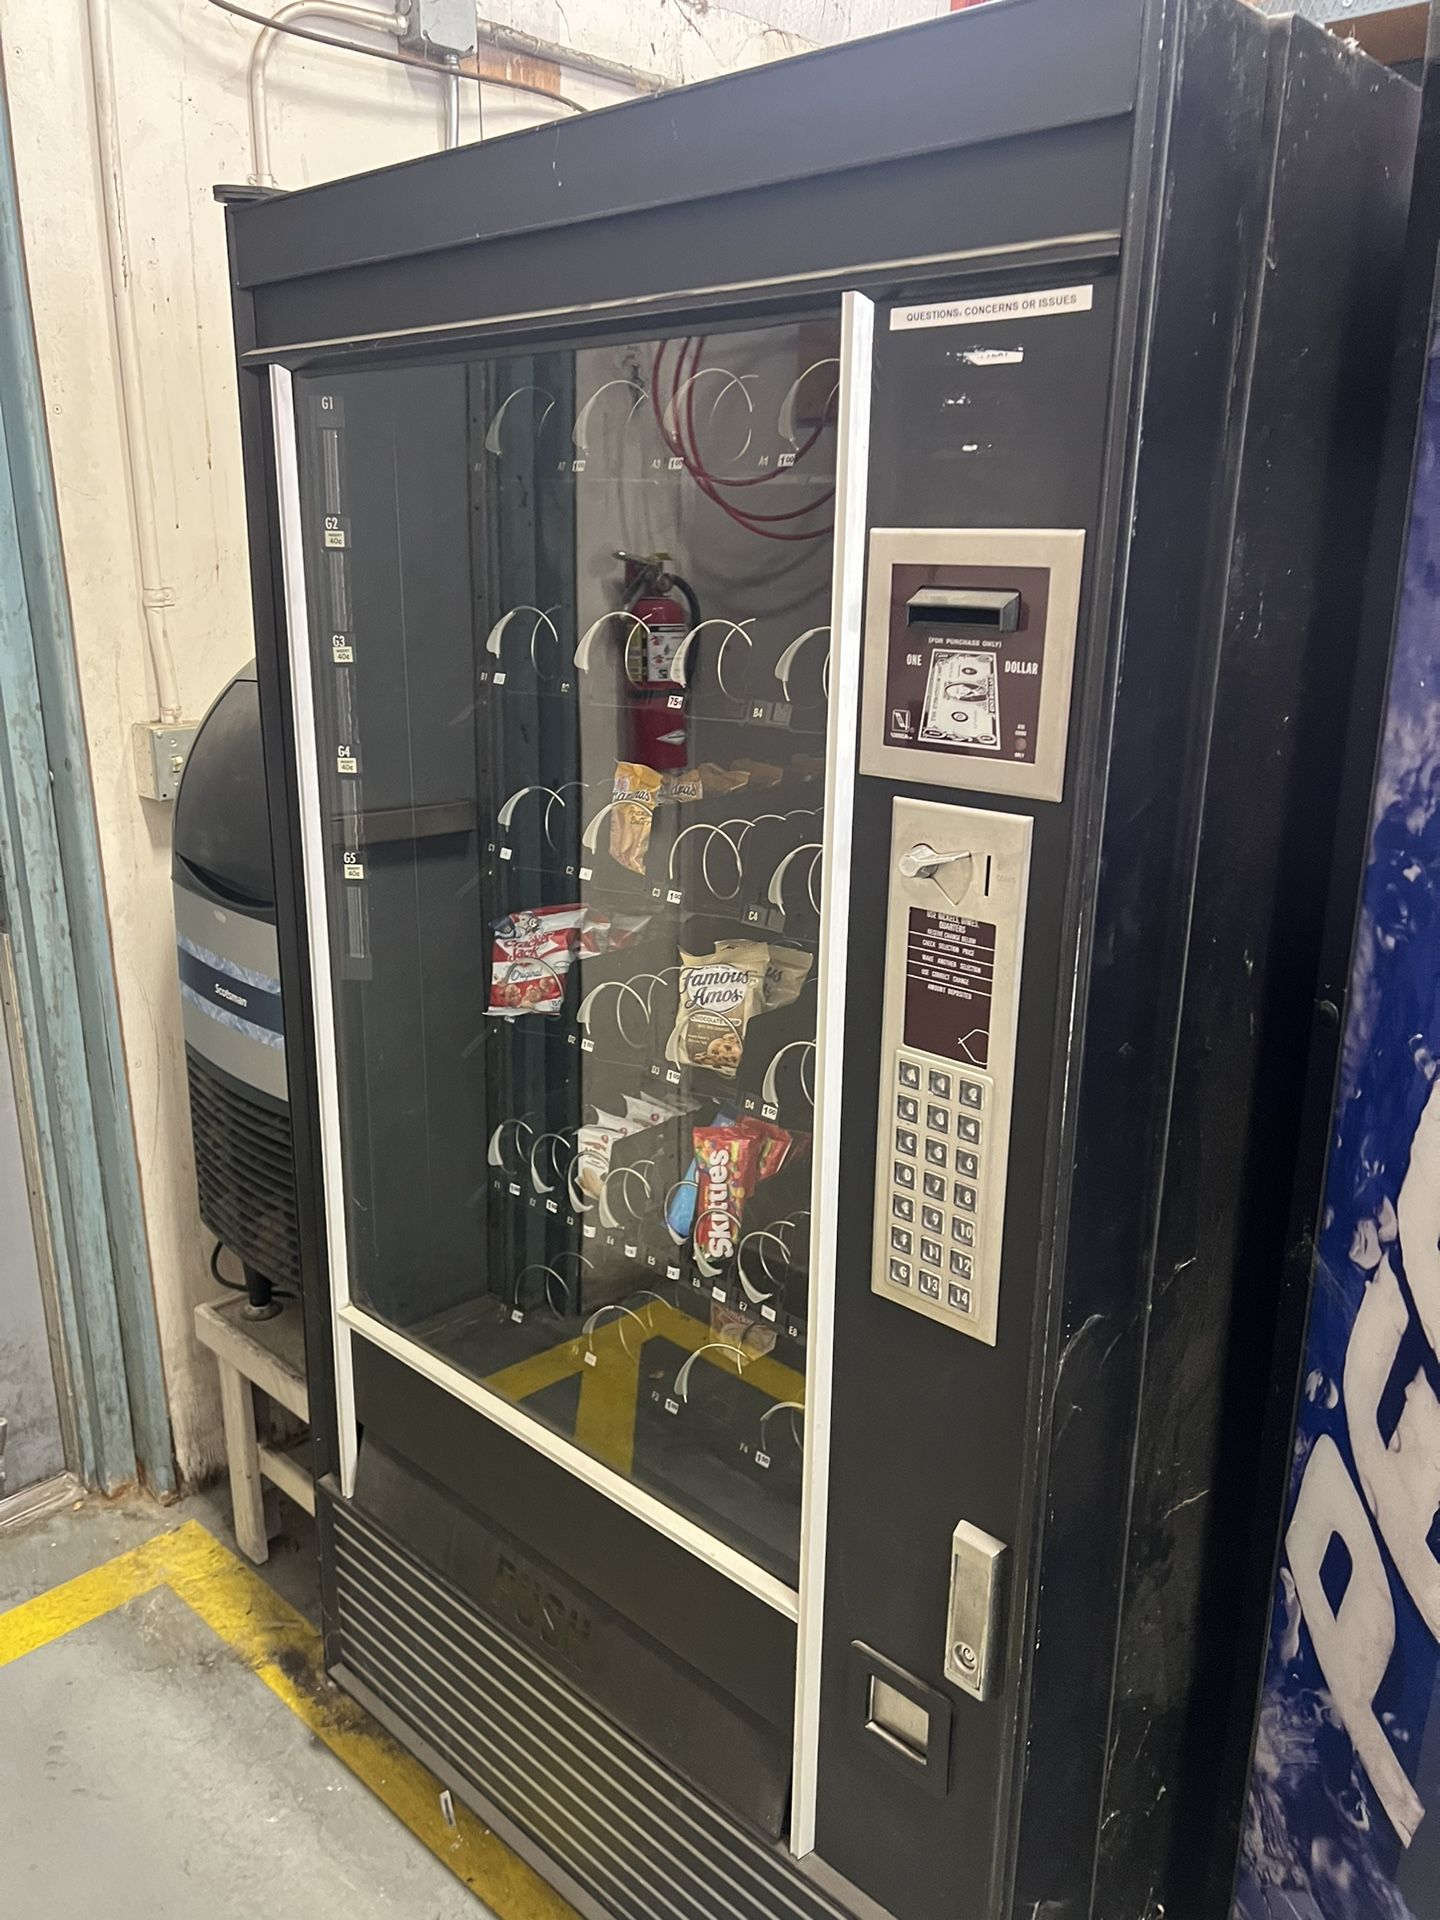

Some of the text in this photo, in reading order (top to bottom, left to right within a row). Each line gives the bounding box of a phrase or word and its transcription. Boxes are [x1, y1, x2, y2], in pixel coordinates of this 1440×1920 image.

[964, 300, 1018, 316] CONCERNS
[1021, 298, 1036, 310] OR
[1038, 294, 1077, 308] ISSUES
[321, 396, 334, 410] G1
[325, 516, 339, 529] G2
[333, 635, 345, 646] G3
[946, 638, 980, 647] PURCHASE
[906, 654, 922, 666] ONE
[1004, 660, 1039, 675] DOLLAR
[338, 746, 350, 758] G4
[344, 852, 356, 864] G5
[748, 910, 758, 921] C4
[504, 932, 554, 948] Cracker
[507, 946, 538, 962] Jack
[922, 939, 975, 957] CHECK SELECTION PRICE
[680, 967, 750, 994] Famous
[215, 983, 247, 1007] Scotsman
[685, 987, 743, 1008] Amos
[907, 1068, 916, 1082] A
[968, 1087, 977, 1101] 2
[966, 1122, 975, 1136] 4
[906, 1136, 913, 1149] C
[966, 1157, 974, 1170] 6
[933, 1180, 941, 1192] 7
[708, 1149, 734, 1258] Skittles
[964, 1191, 972, 1204] 8
[932, 1213, 939, 1226] 9
[960, 1223, 973, 1239] 10
[928, 1244, 940, 1259] 11
[958, 1256, 972, 1272] 12
[899, 1265, 907, 1278] G
[926, 1276, 938, 1292] 13
[956, 1289, 968, 1305] 14
